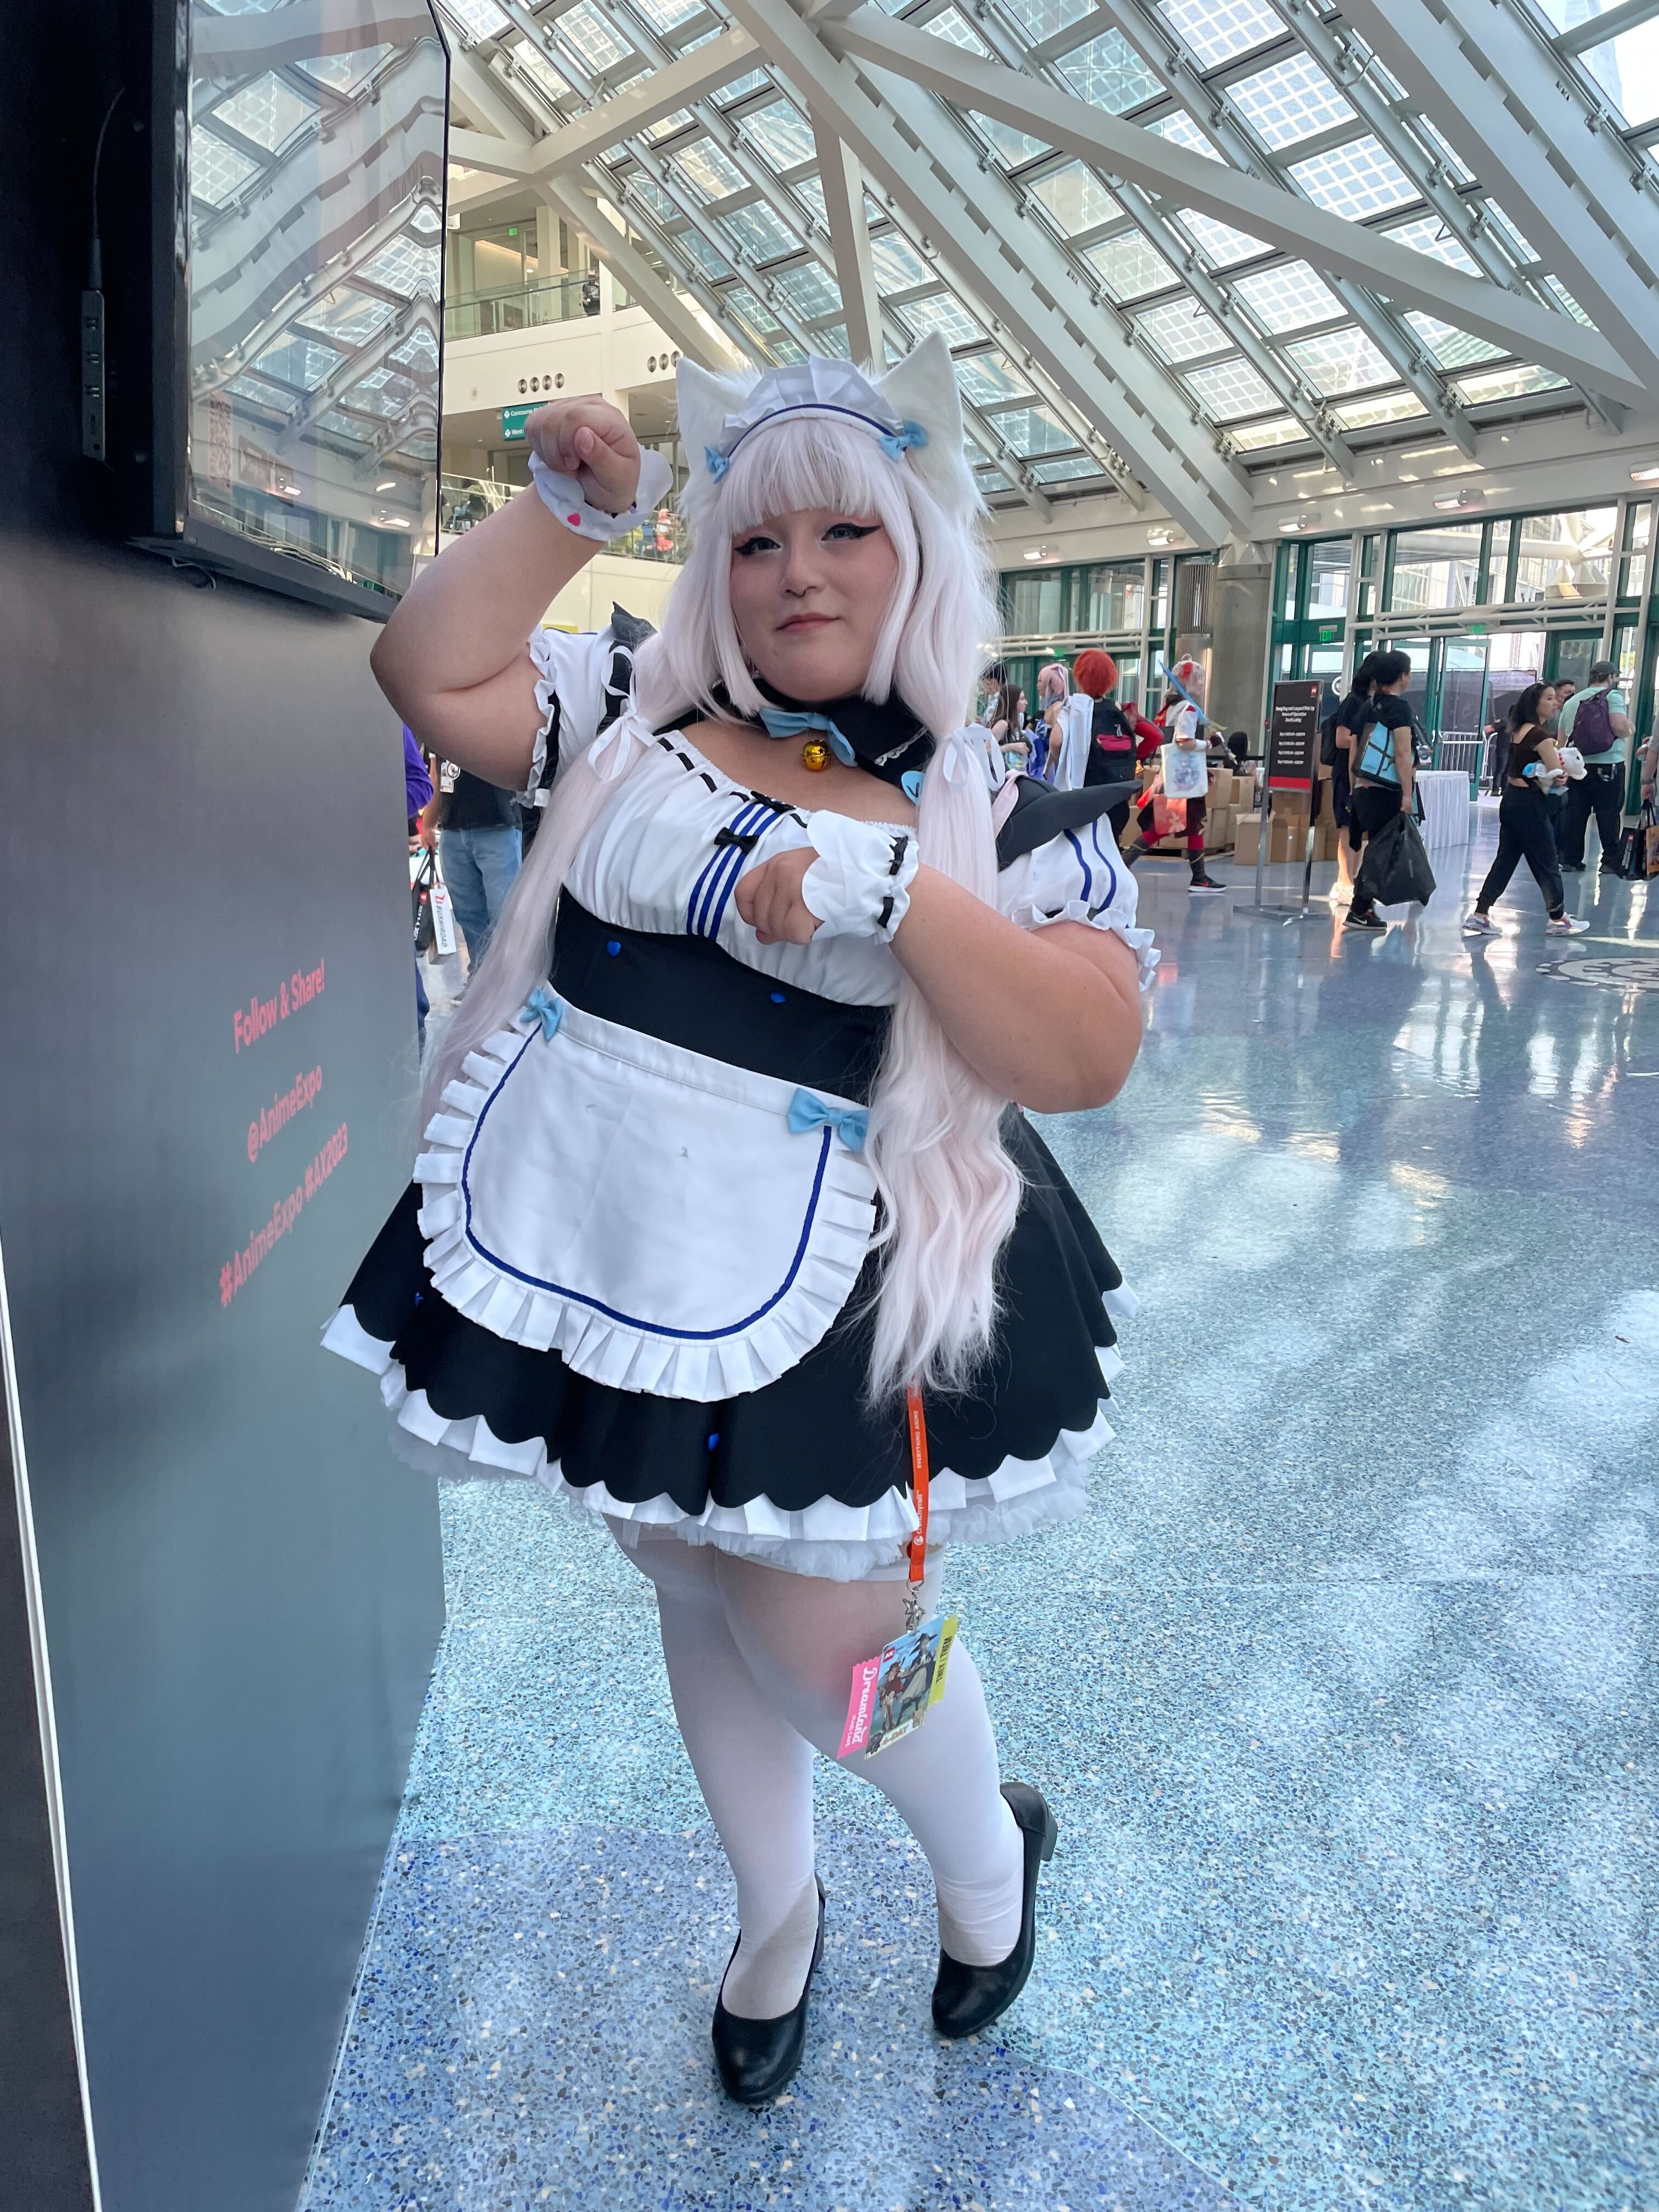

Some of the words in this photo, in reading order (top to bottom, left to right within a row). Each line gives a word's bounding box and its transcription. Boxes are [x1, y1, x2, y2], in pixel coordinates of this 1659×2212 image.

[437, 905, 448, 947] BUSHIROAD
[234, 996, 276, 1053] Follow
[280, 981, 290, 1020] &
[291, 957, 325, 1011] Share!
[248, 1065, 322, 1163] @AnimeExpo
[220, 1186, 303, 1308] #AnimeExpo
[304, 1122, 348, 1200] #AX2023
[851, 1667, 878, 1744] Dreamland
